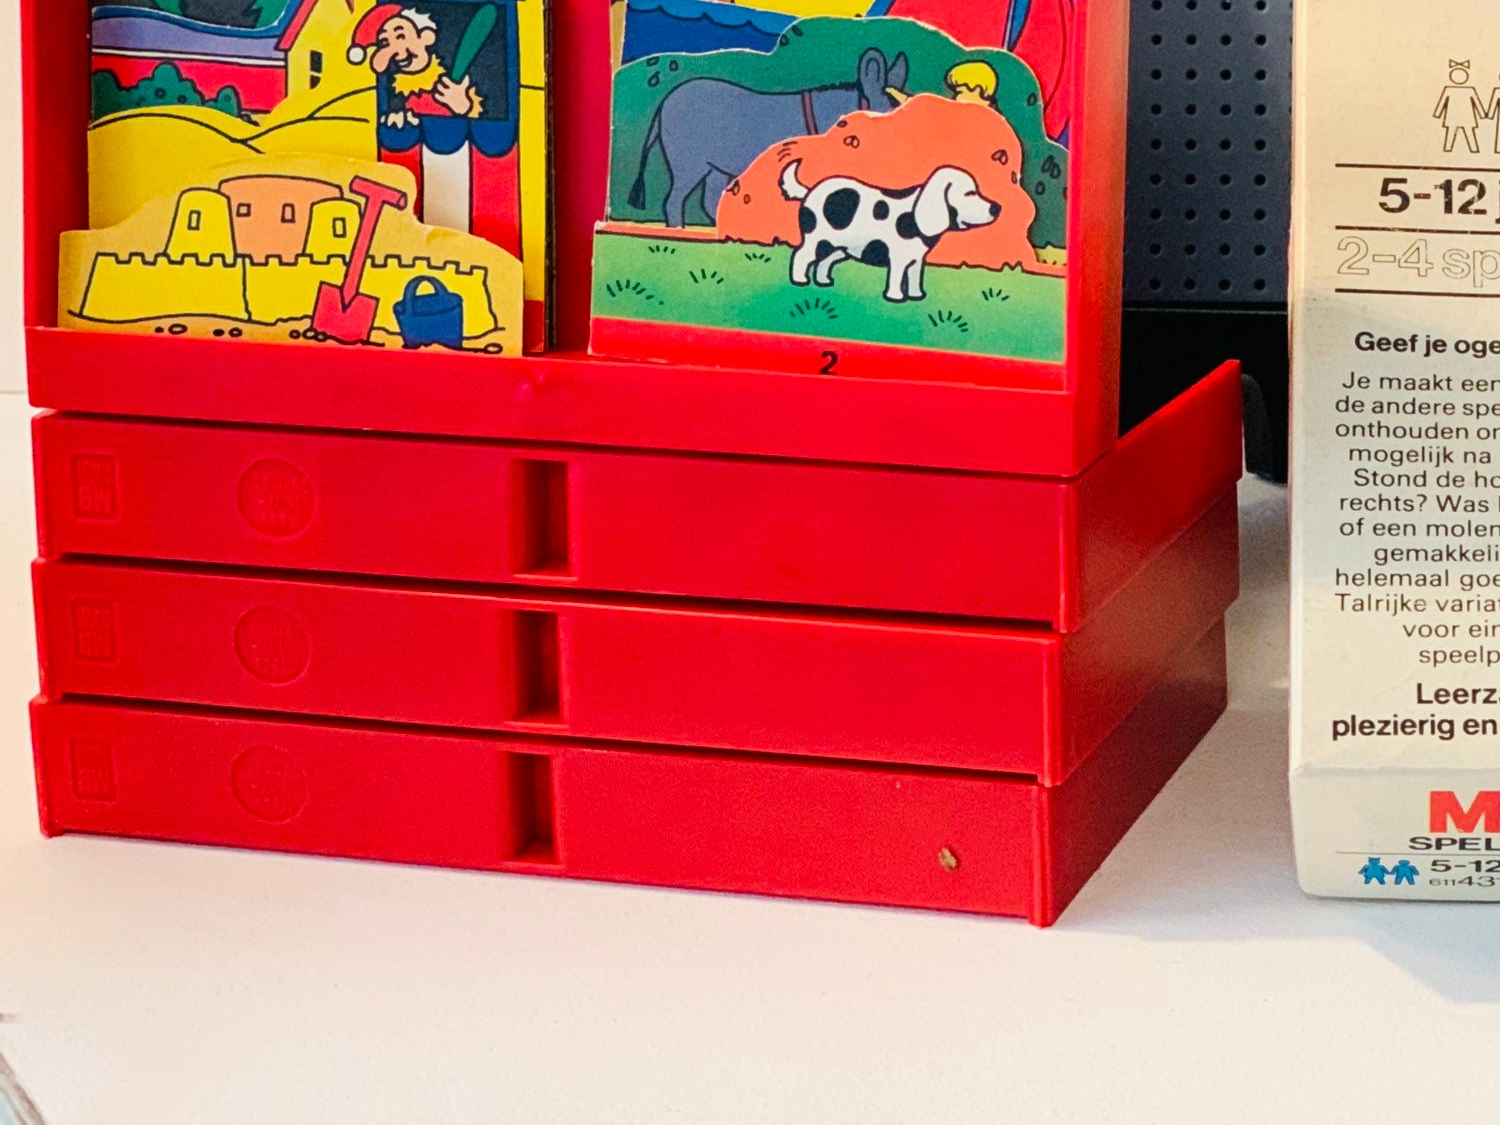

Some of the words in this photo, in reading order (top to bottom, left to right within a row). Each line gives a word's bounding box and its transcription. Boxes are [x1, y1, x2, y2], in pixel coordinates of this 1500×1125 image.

[1379, 178, 1487, 215] 5-12
[1337, 236, 1433, 277] 2-4
[1355, 332, 1418, 352] Geef
[1424, 335, 1447, 357] je
[820, 352, 839, 375] 2
[1342, 371, 1370, 389] Je
[1380, 374, 1452, 391] maakt
[1336, 396, 1364, 413] de
[1372, 398, 1455, 415] andere
[1336, 421, 1468, 439] onthouden
[1350, 446, 1453, 467] mogelijk
[1464, 451, 1491, 464] na
[1354, 468, 1426, 487] Stond
[1436, 471, 1465, 488] de
[1340, 494, 1427, 512] rechts?
[1436, 495, 1489, 512] Was
[1340, 518, 1364, 536] of
[1373, 523, 1416, 536] een
[1336, 568, 1448, 587] helemaal
[1335, 593, 1426, 616] Talrijke
[1403, 624, 1459, 637] voor
[1333, 714, 1454, 741] plezierig
[1463, 719, 1497, 735] en
